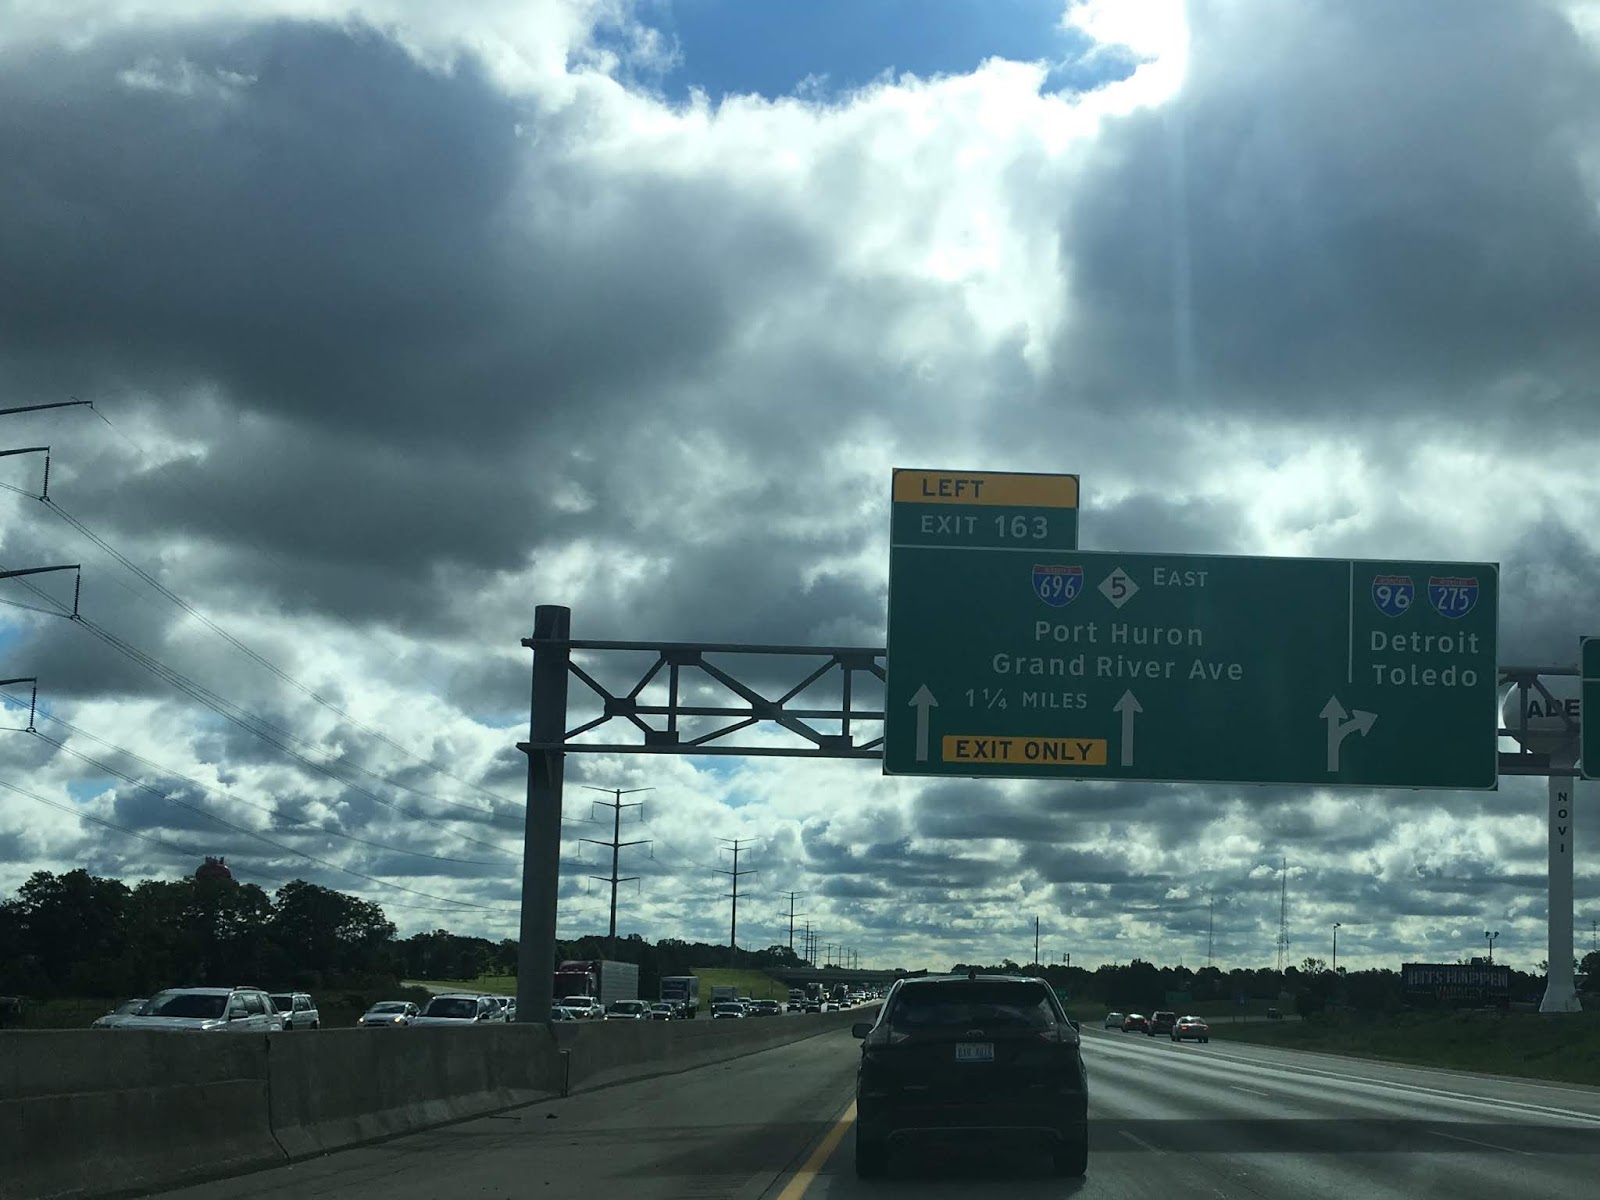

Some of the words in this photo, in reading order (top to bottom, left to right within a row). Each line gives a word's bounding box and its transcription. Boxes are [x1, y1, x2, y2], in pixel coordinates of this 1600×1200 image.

[922, 478, 985, 498] LEFT
[921, 514, 979, 534] EXIT
[994, 514, 1049, 539] 163
[1040, 574, 1076, 599] 696
[1111, 576, 1127, 599] 5
[1153, 567, 1209, 588] EAST
[1376, 585, 1411, 609] 96
[1437, 587, 1470, 611] 275
[1035, 620, 1098, 643] Port
[1111, 622, 1204, 647] Huron
[1370, 630, 1480, 654] Detroit
[992, 652, 1086, 677] Grand
[1096, 655, 1177, 679] River
[1188, 658, 1244, 681] Ave
[1371, 663, 1478, 687] Toledo
[1022, 691, 1088, 711] MILES
[955, 739, 1013, 760] EXIT
[1024, 741, 1094, 762] ONLY
[1557, 792, 1569, 853] NOVI
